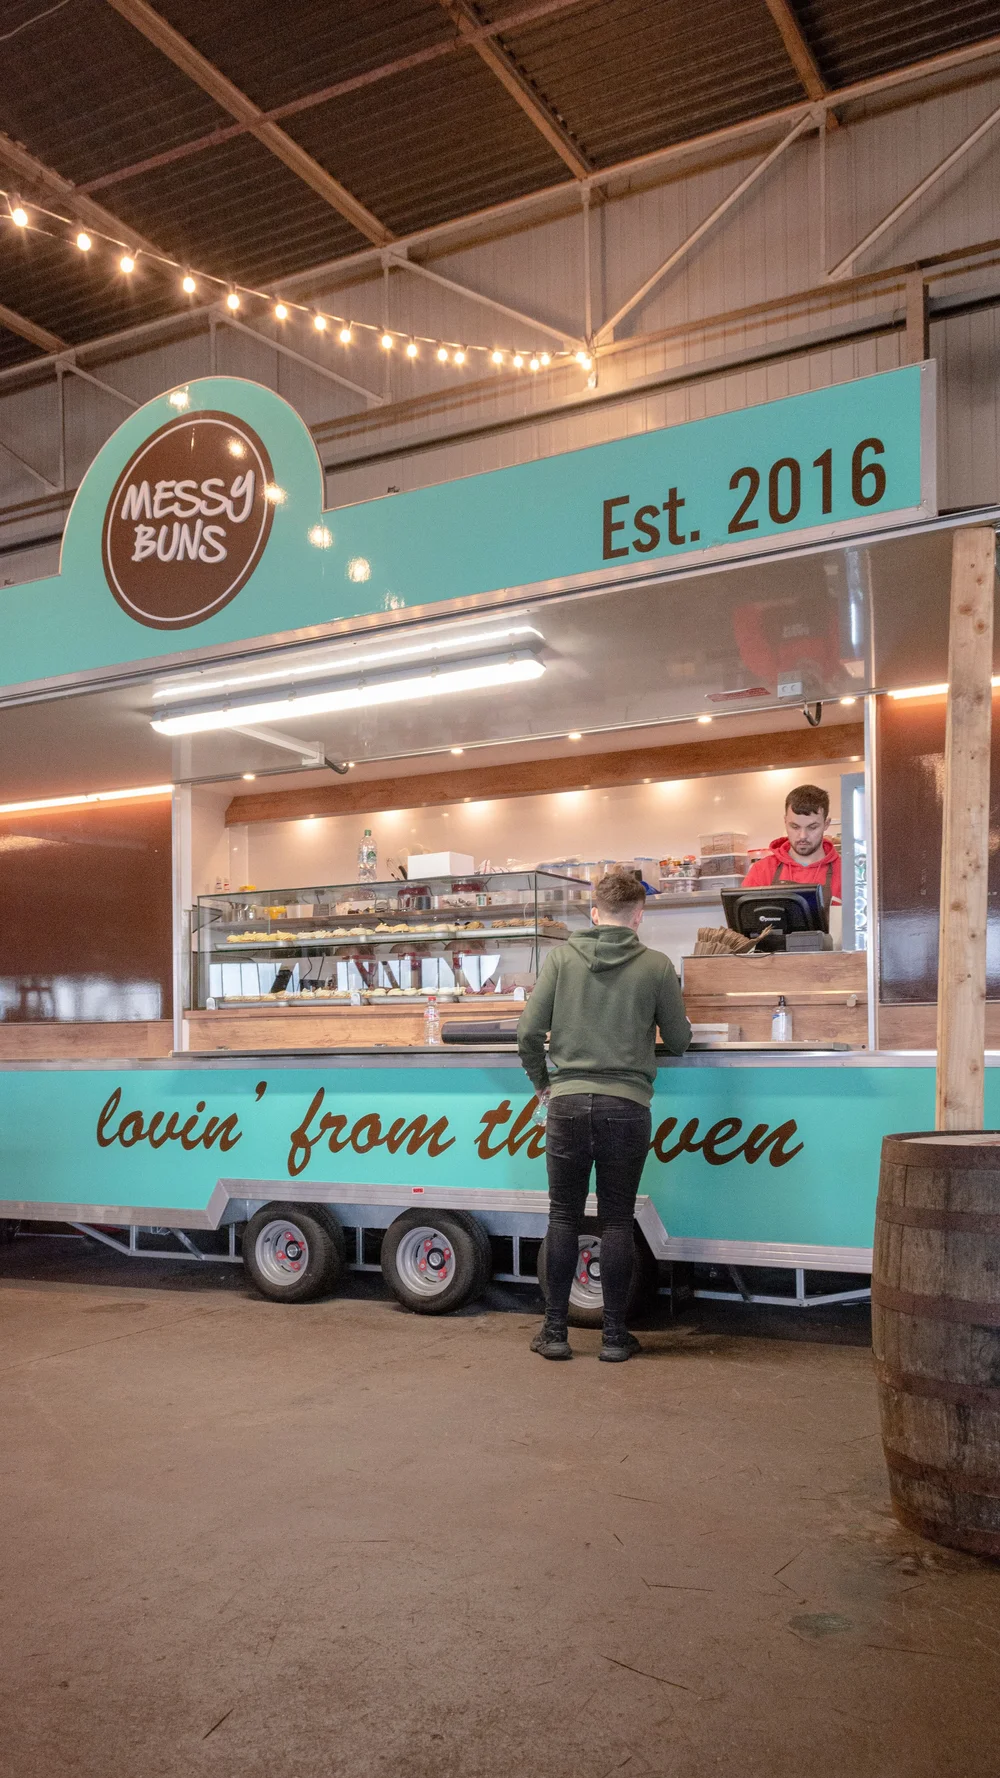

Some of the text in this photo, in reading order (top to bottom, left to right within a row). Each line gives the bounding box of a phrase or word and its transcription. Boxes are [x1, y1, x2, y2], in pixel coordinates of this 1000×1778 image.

[120, 469, 256, 524] MESSY
[602, 437, 887, 561] Est. 2016
[131, 518, 228, 564] BUNS
[287, 1087, 456, 1177] from
[474, 1094, 547, 1160] th
[650, 1116, 805, 1168] ven
